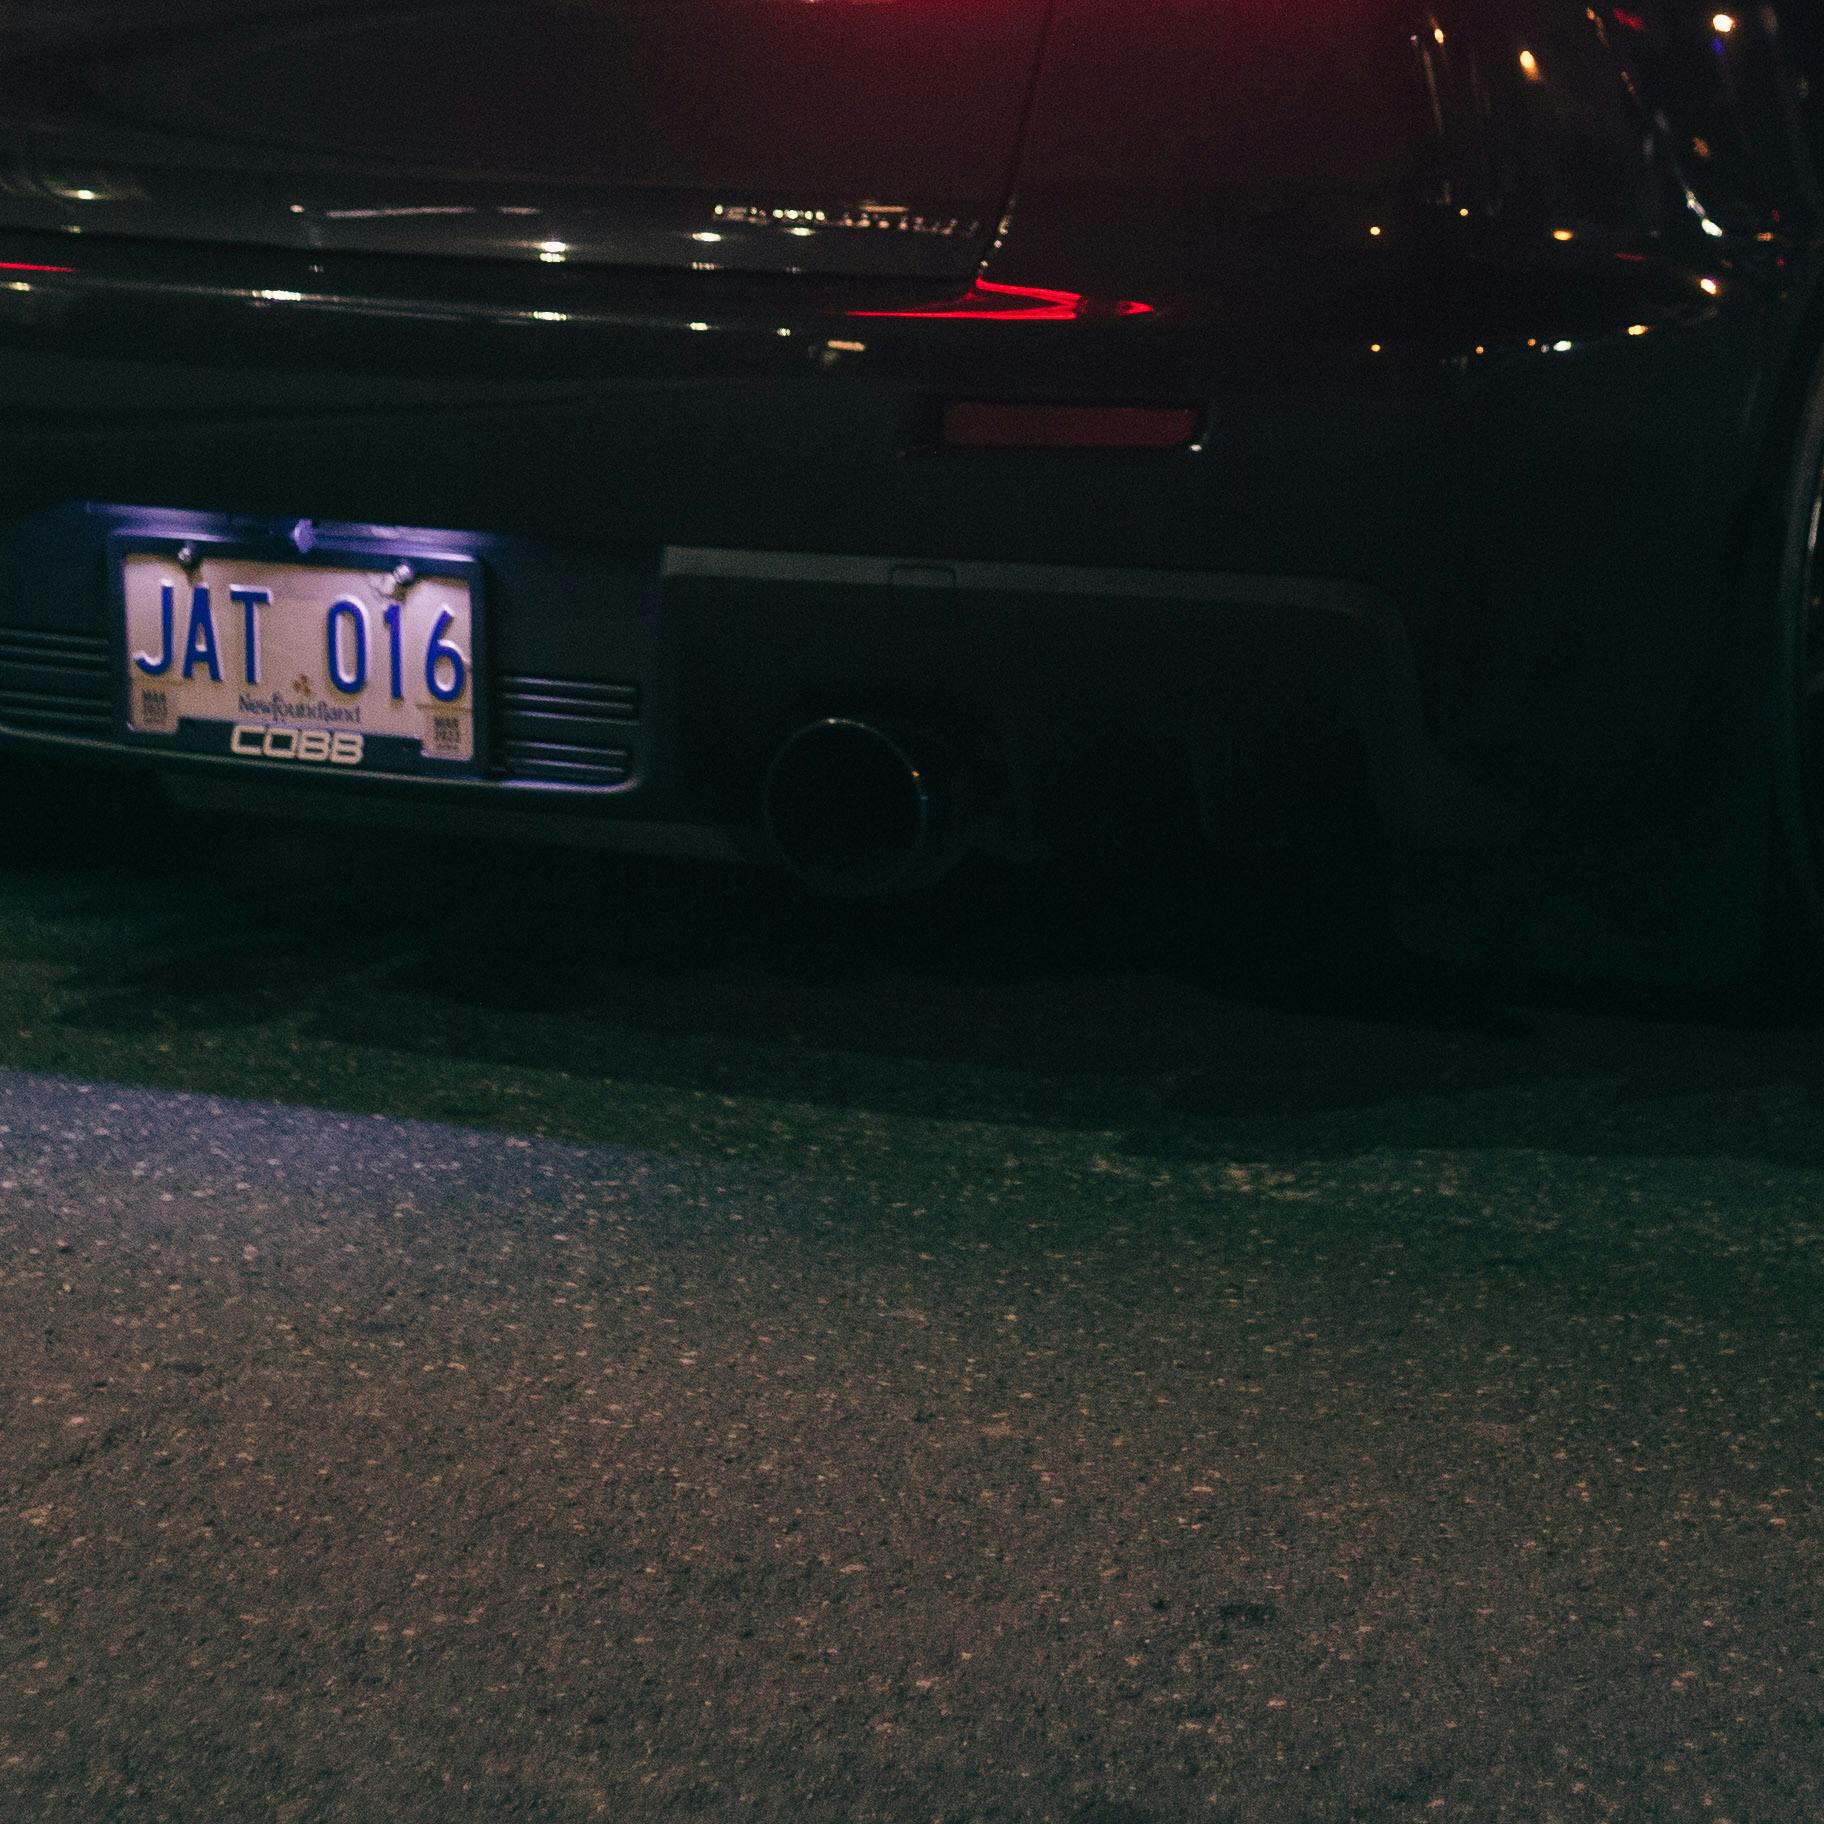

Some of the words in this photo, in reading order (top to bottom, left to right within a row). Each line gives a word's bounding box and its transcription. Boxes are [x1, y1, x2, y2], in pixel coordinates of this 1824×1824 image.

[134, 579, 271, 684] JAT
[327, 596, 469, 702] 016
[231, 726, 364, 765] COBB
